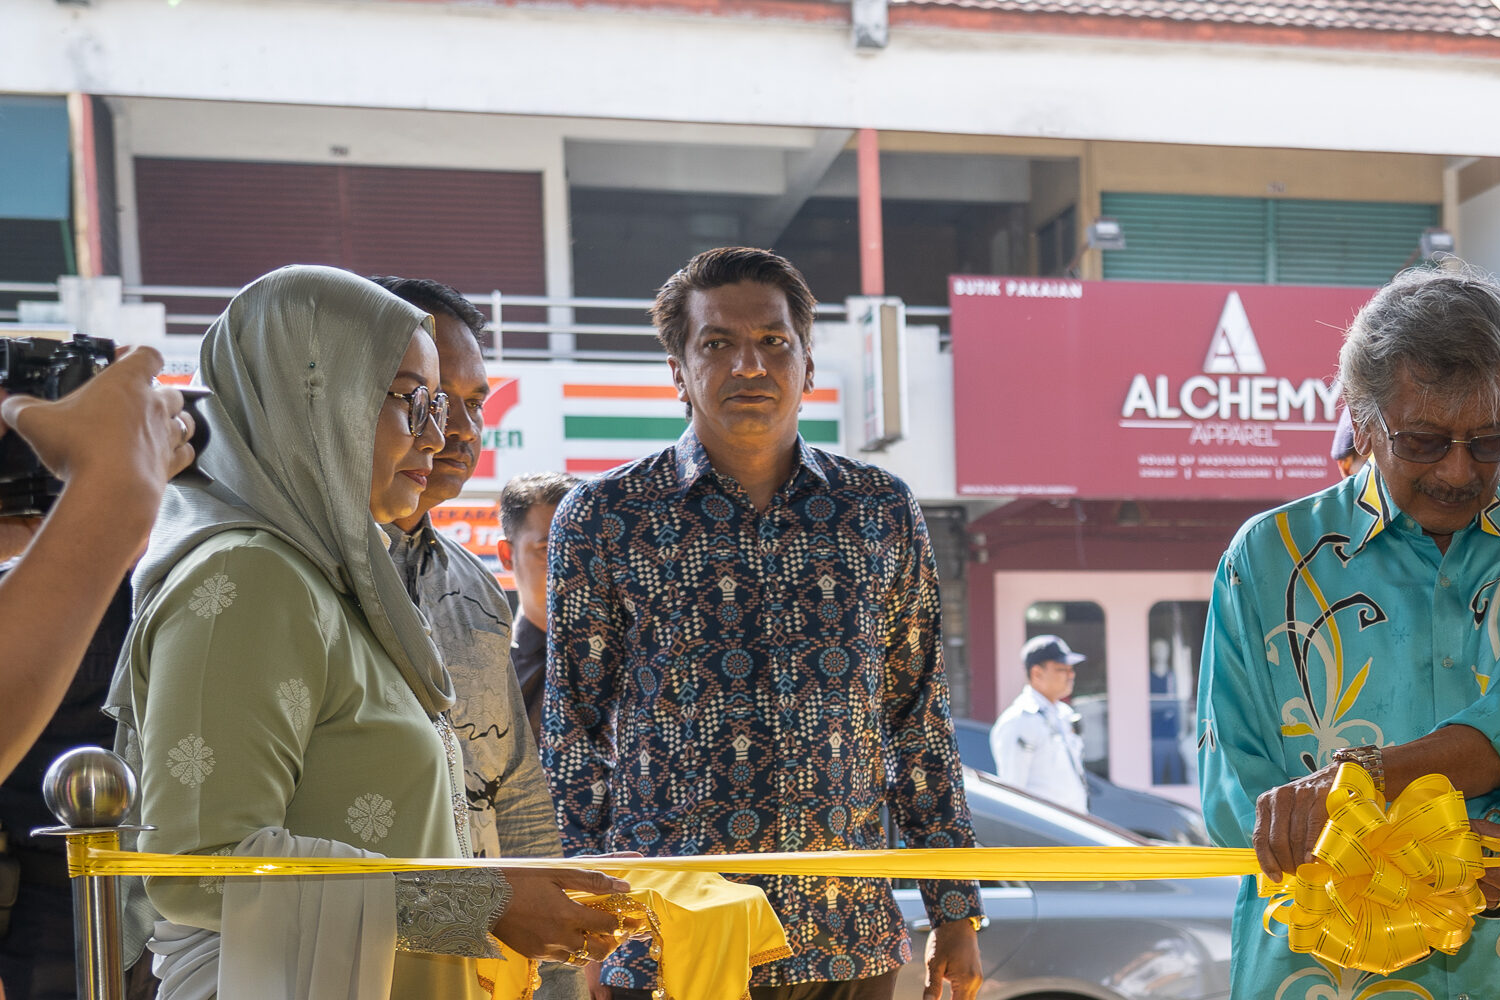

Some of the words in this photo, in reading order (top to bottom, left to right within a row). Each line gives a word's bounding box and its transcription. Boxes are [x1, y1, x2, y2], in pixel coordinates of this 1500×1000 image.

[953, 278, 1001, 296] BUTIK
[1005, 279, 1083, 299] PAKAIAN
[1121, 373, 1342, 422] ALCHEMY
[1189, 423, 1280, 447] APPAREL
